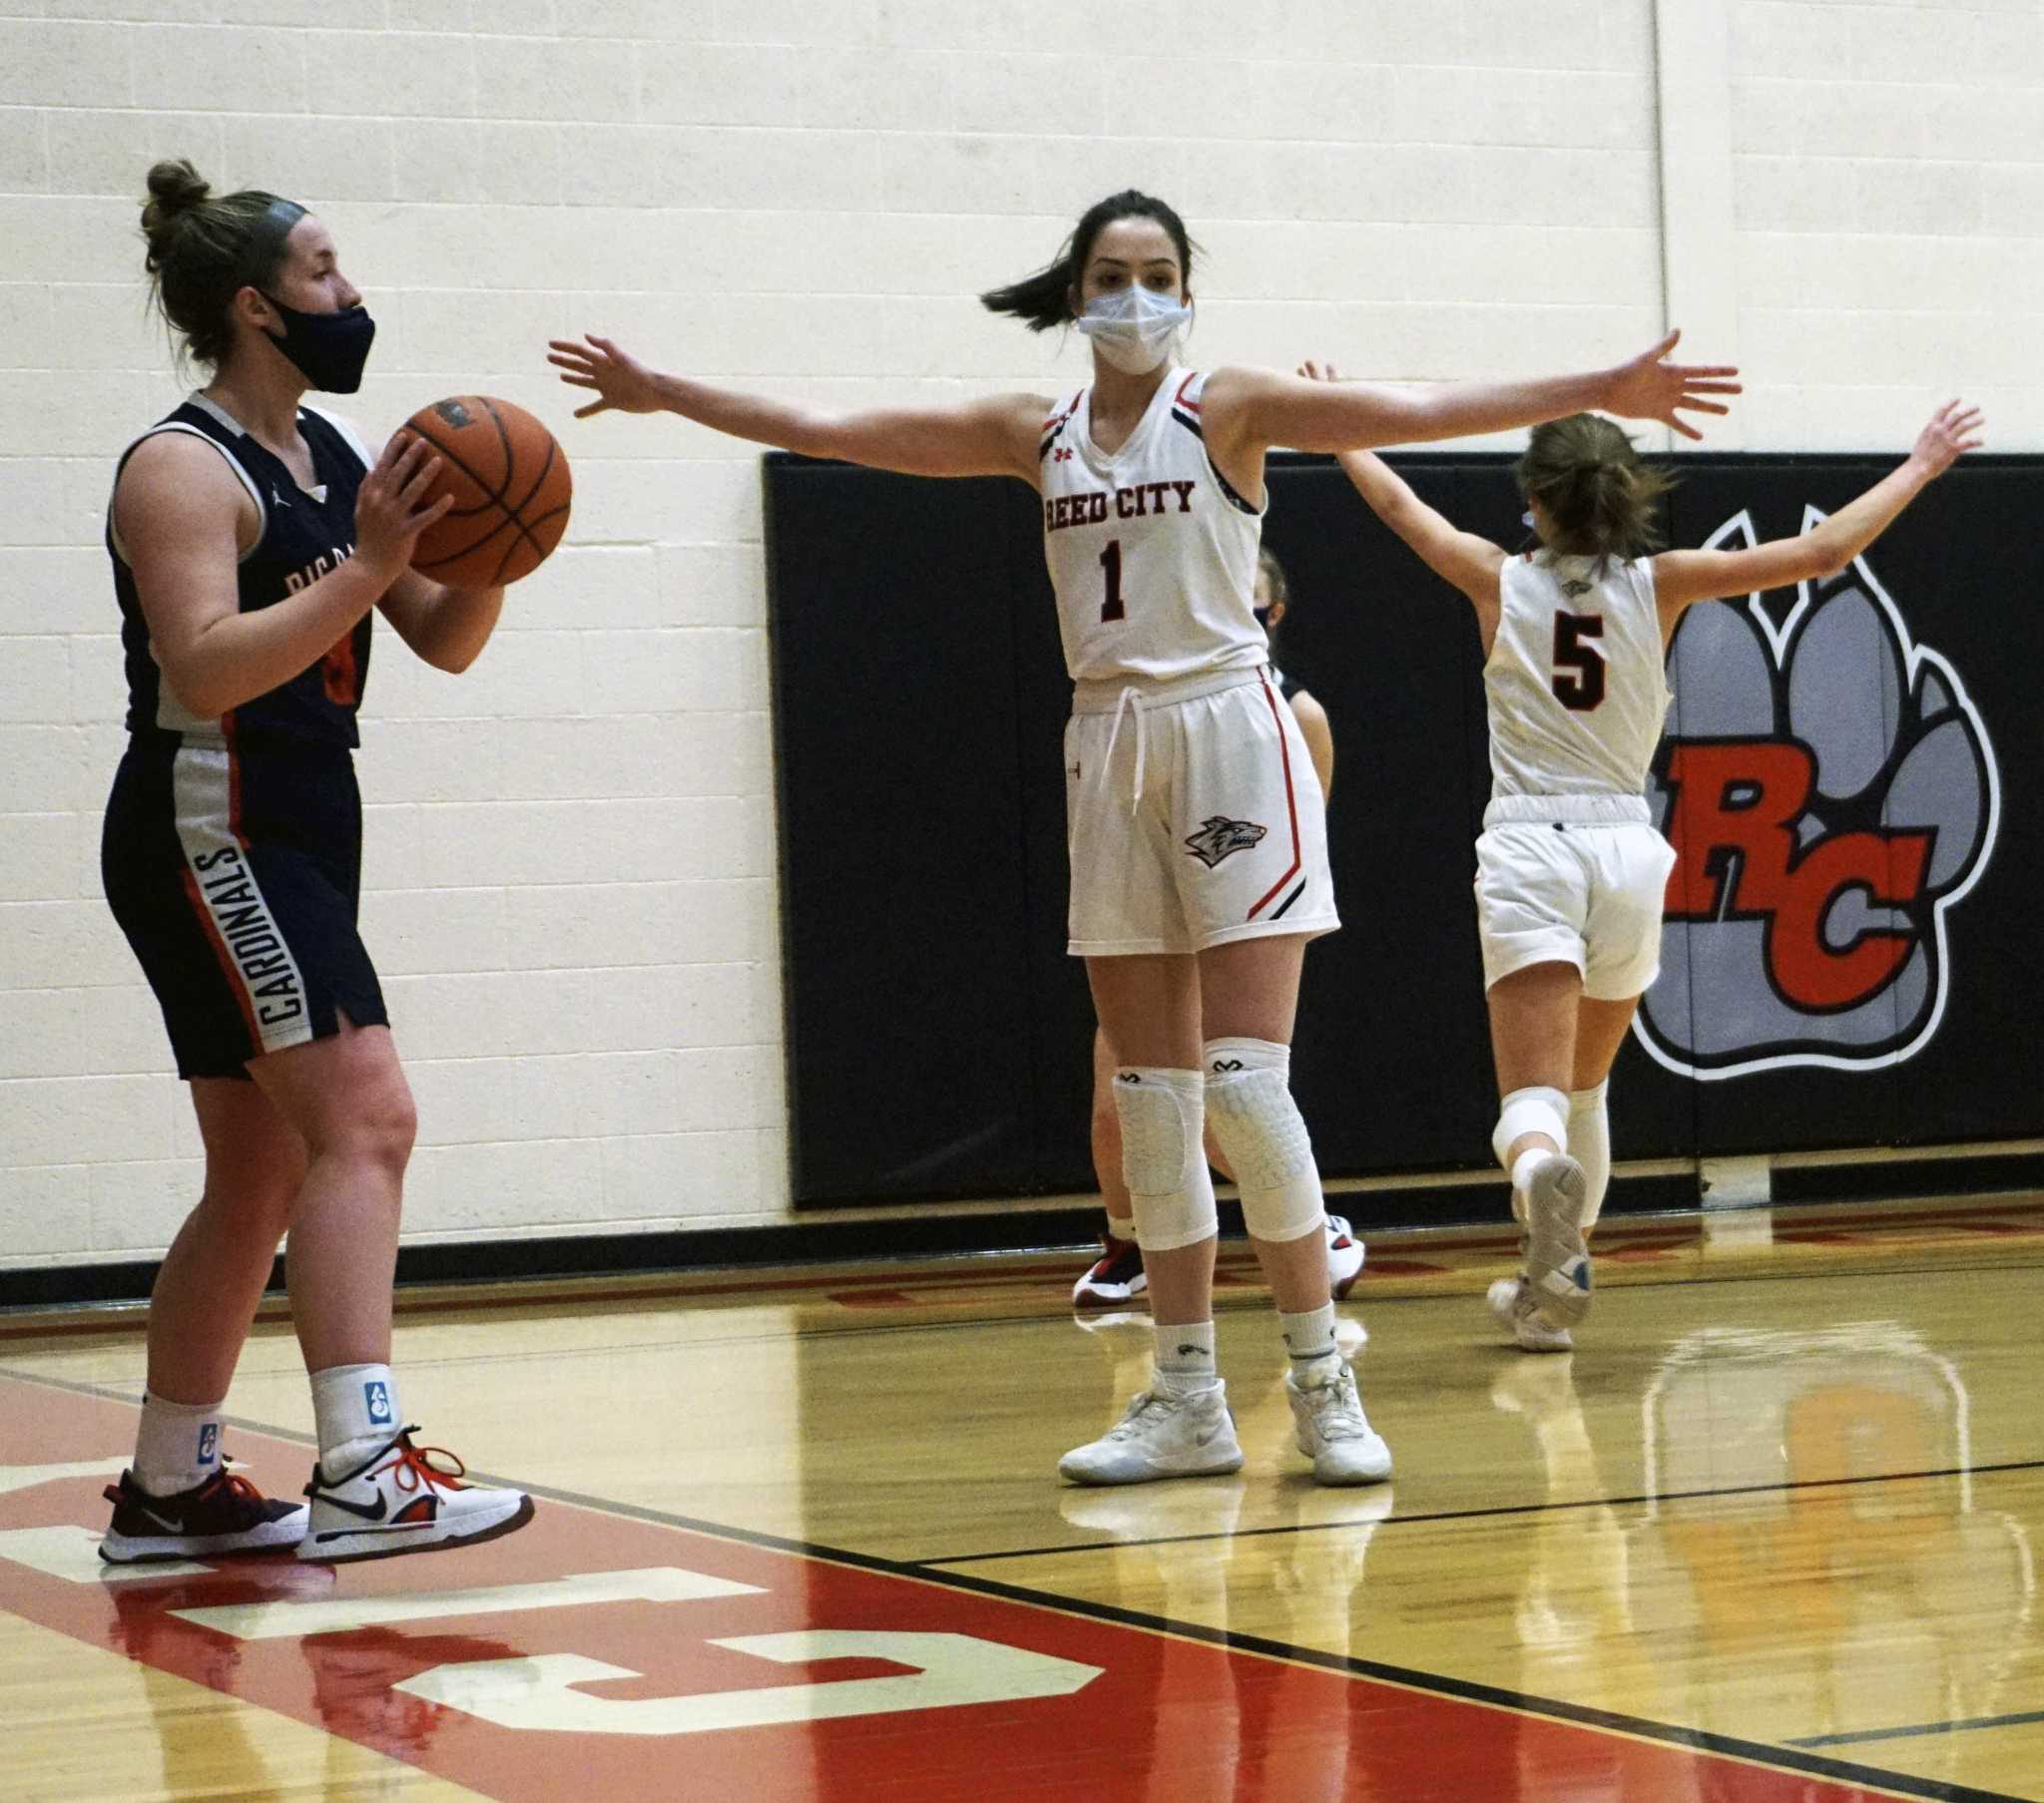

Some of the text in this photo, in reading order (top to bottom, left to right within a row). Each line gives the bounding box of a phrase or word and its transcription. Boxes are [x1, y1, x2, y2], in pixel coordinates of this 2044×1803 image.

[1116, 481, 1196, 519] CITY
[1100, 540, 1125, 623] 1
[1552, 610, 1606, 711] 5
[1657, 738, 1936, 1013] RC
[194, 846, 301, 1027] CARDINALS
